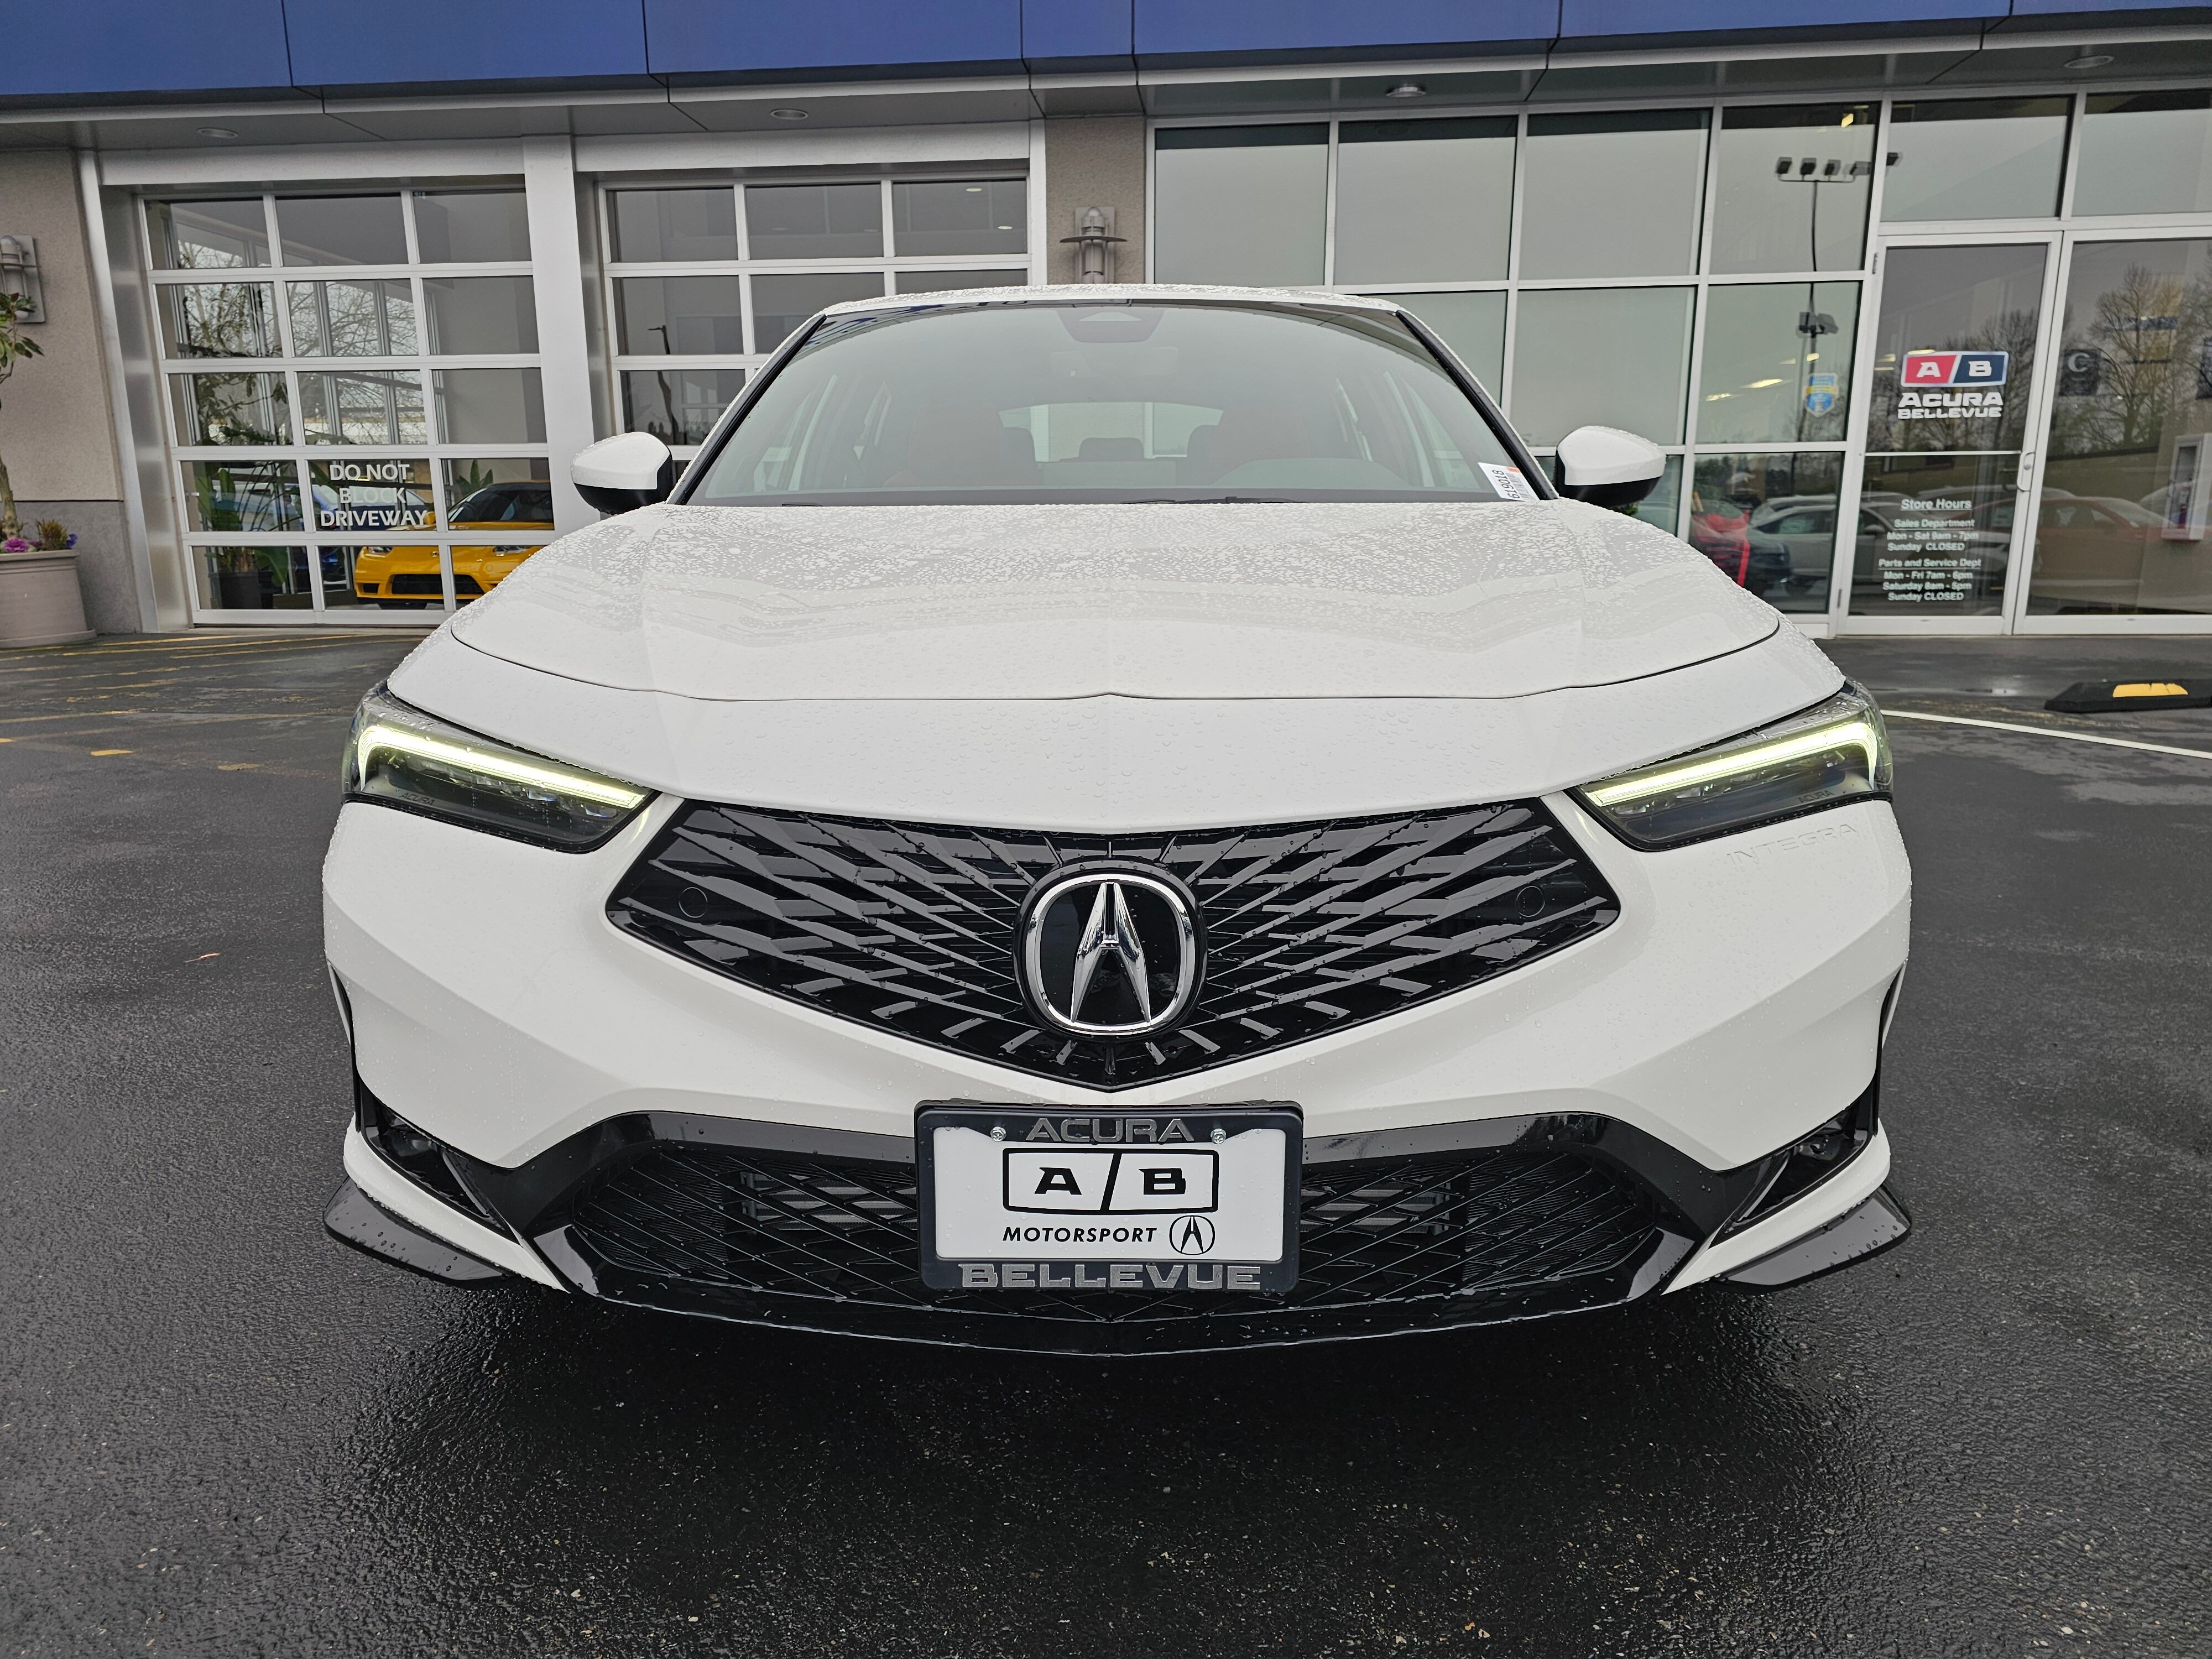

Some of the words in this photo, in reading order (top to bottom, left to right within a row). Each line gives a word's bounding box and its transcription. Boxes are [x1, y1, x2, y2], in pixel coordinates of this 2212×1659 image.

[1916, 362, 1941, 378] A
[1968, 361, 1992, 377] B
[1898, 392, 2004, 408] ACURA
[1897, 406, 2002, 419] BELLEVUE
[330, 464, 361, 481] DO
[366, 464, 410, 481] NOT
[1491, 469, 1520, 499] 619018
[339, 487, 406, 504] BLOCK
[1901, 498, 1933, 509] Store
[1936, 498, 1972, 509] Hours
[320, 510, 427, 526] DRIVEWAY
[1894, 519, 1919, 528] Sales
[1921, 519, 1975, 529] Department
[1887, 531, 1907, 540] Mon
[1914, 531, 1930, 540] Sat
[1959, 531, 1979, 541] 7pm
[1887, 542, 1922, 552] Sunday
[1926, 542, 1965, 551] CLOSED
[1879, 559, 1902, 567] Parts
[1904, 559, 1922, 567] and
[1923, 558, 1958, 567] Service
[1959, 558, 1981, 568] Dept
[1884, 571, 1903, 579] Mon
[1911, 571, 1924, 579] Fri
[1882, 581, 1923, 592] Saturday
[1888, 592, 1923, 602] Sunday
[1924, 592, 1964, 601] CLOSED
[399, 792, 435, 806] ACURA
[1798, 790, 1835, 803] ACURA
[1726, 824, 1858, 865] INTEGRA
[1025, 1118, 1194, 1143] ACURA
[1034, 1167, 1082, 1196] A
[1139, 1167, 1186, 1195] B
[1002, 1227, 1157, 1243] MOTORSPORT
[958, 1263, 1261, 1290] BELLEVUE
